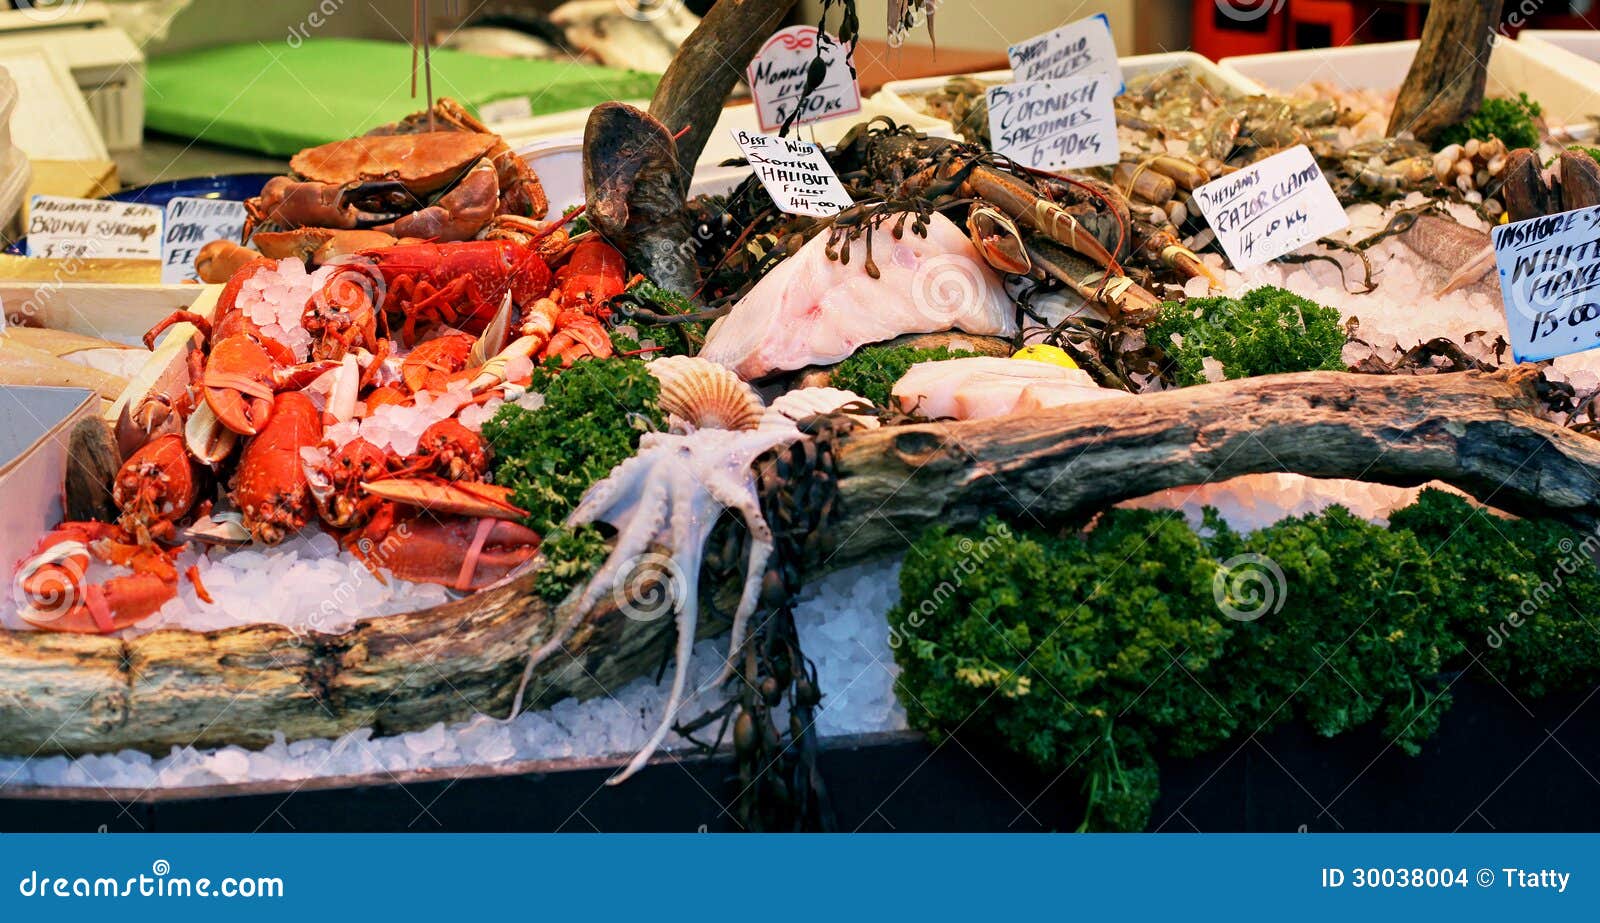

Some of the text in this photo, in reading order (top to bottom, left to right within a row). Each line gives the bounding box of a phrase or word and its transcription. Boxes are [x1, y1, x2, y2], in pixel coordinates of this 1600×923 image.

[990, 83, 1037, 104] BEST
[1001, 81, 1099, 130] CORNISH
[738, 131, 769, 146] BEST
[998, 108, 1092, 151] SARDINES
[762, 166, 834, 186] HALIBUT
[167, 222, 207, 243] OAK
[1214, 190, 1271, 235] RAZOR
[1495, 210, 1580, 251] INSHORE
[1528, 262, 1600, 303] HAKE
